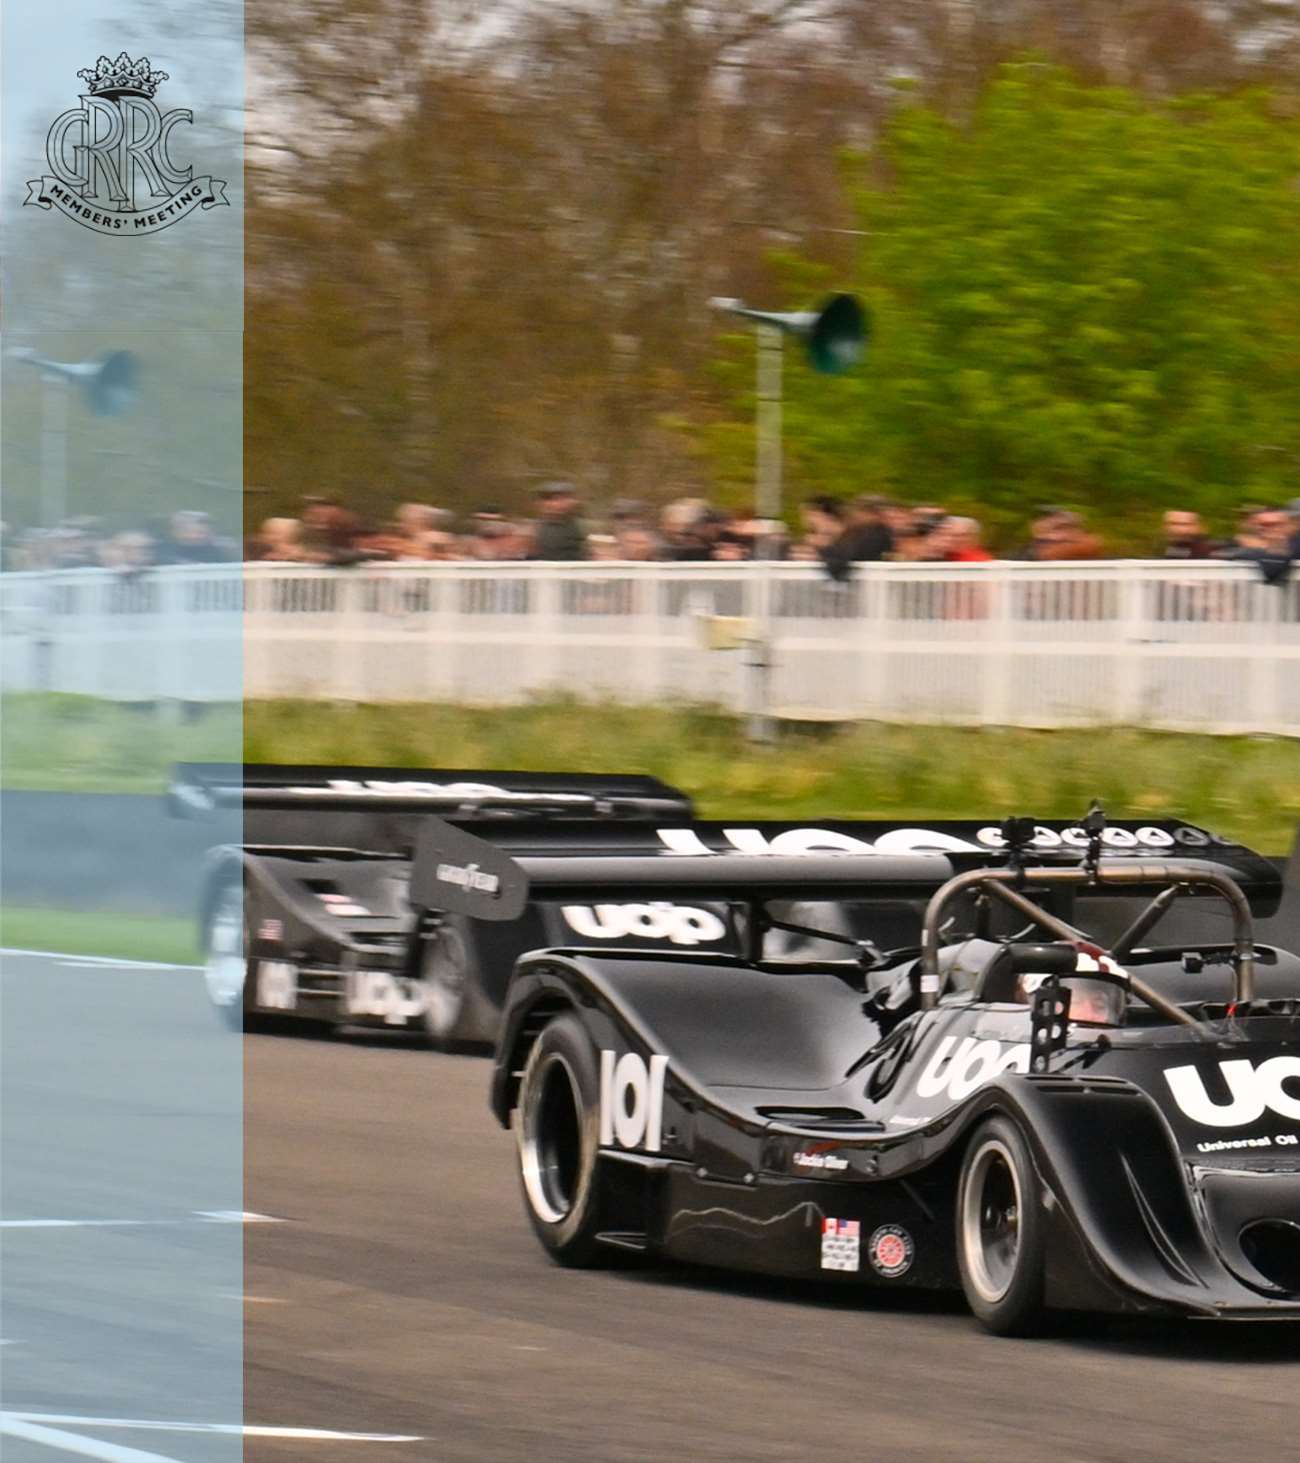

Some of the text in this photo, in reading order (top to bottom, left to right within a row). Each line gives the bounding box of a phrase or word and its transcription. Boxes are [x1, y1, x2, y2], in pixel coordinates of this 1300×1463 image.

[600, 1050, 670, 1151] 101
[1196, 1135, 1271, 1153] Universal
[1274, 1133, 1299, 1146] Oil
